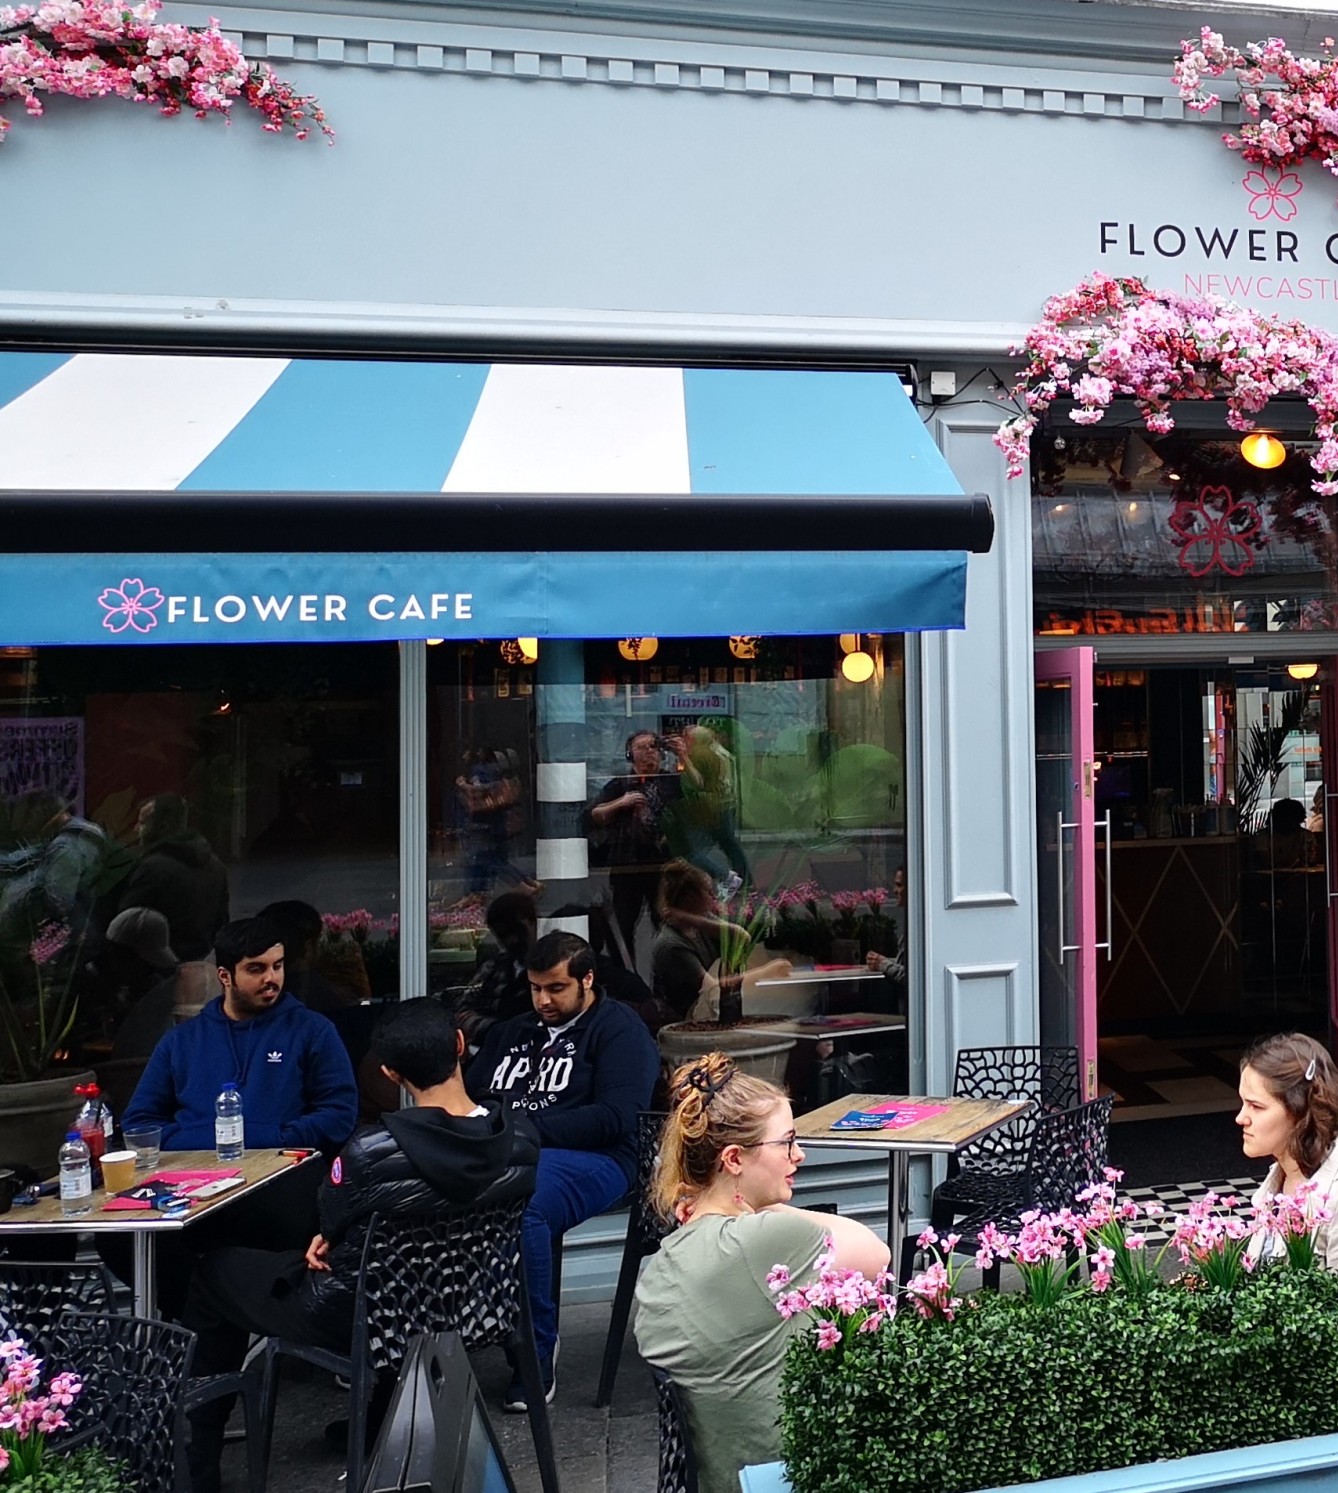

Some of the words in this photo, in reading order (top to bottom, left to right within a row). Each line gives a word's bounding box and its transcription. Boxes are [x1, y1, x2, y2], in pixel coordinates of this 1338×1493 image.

[1100, 221, 1298, 263] FLOWER
[167, 594, 346, 624] FLOWER
[368, 593, 473, 621] CAFE
